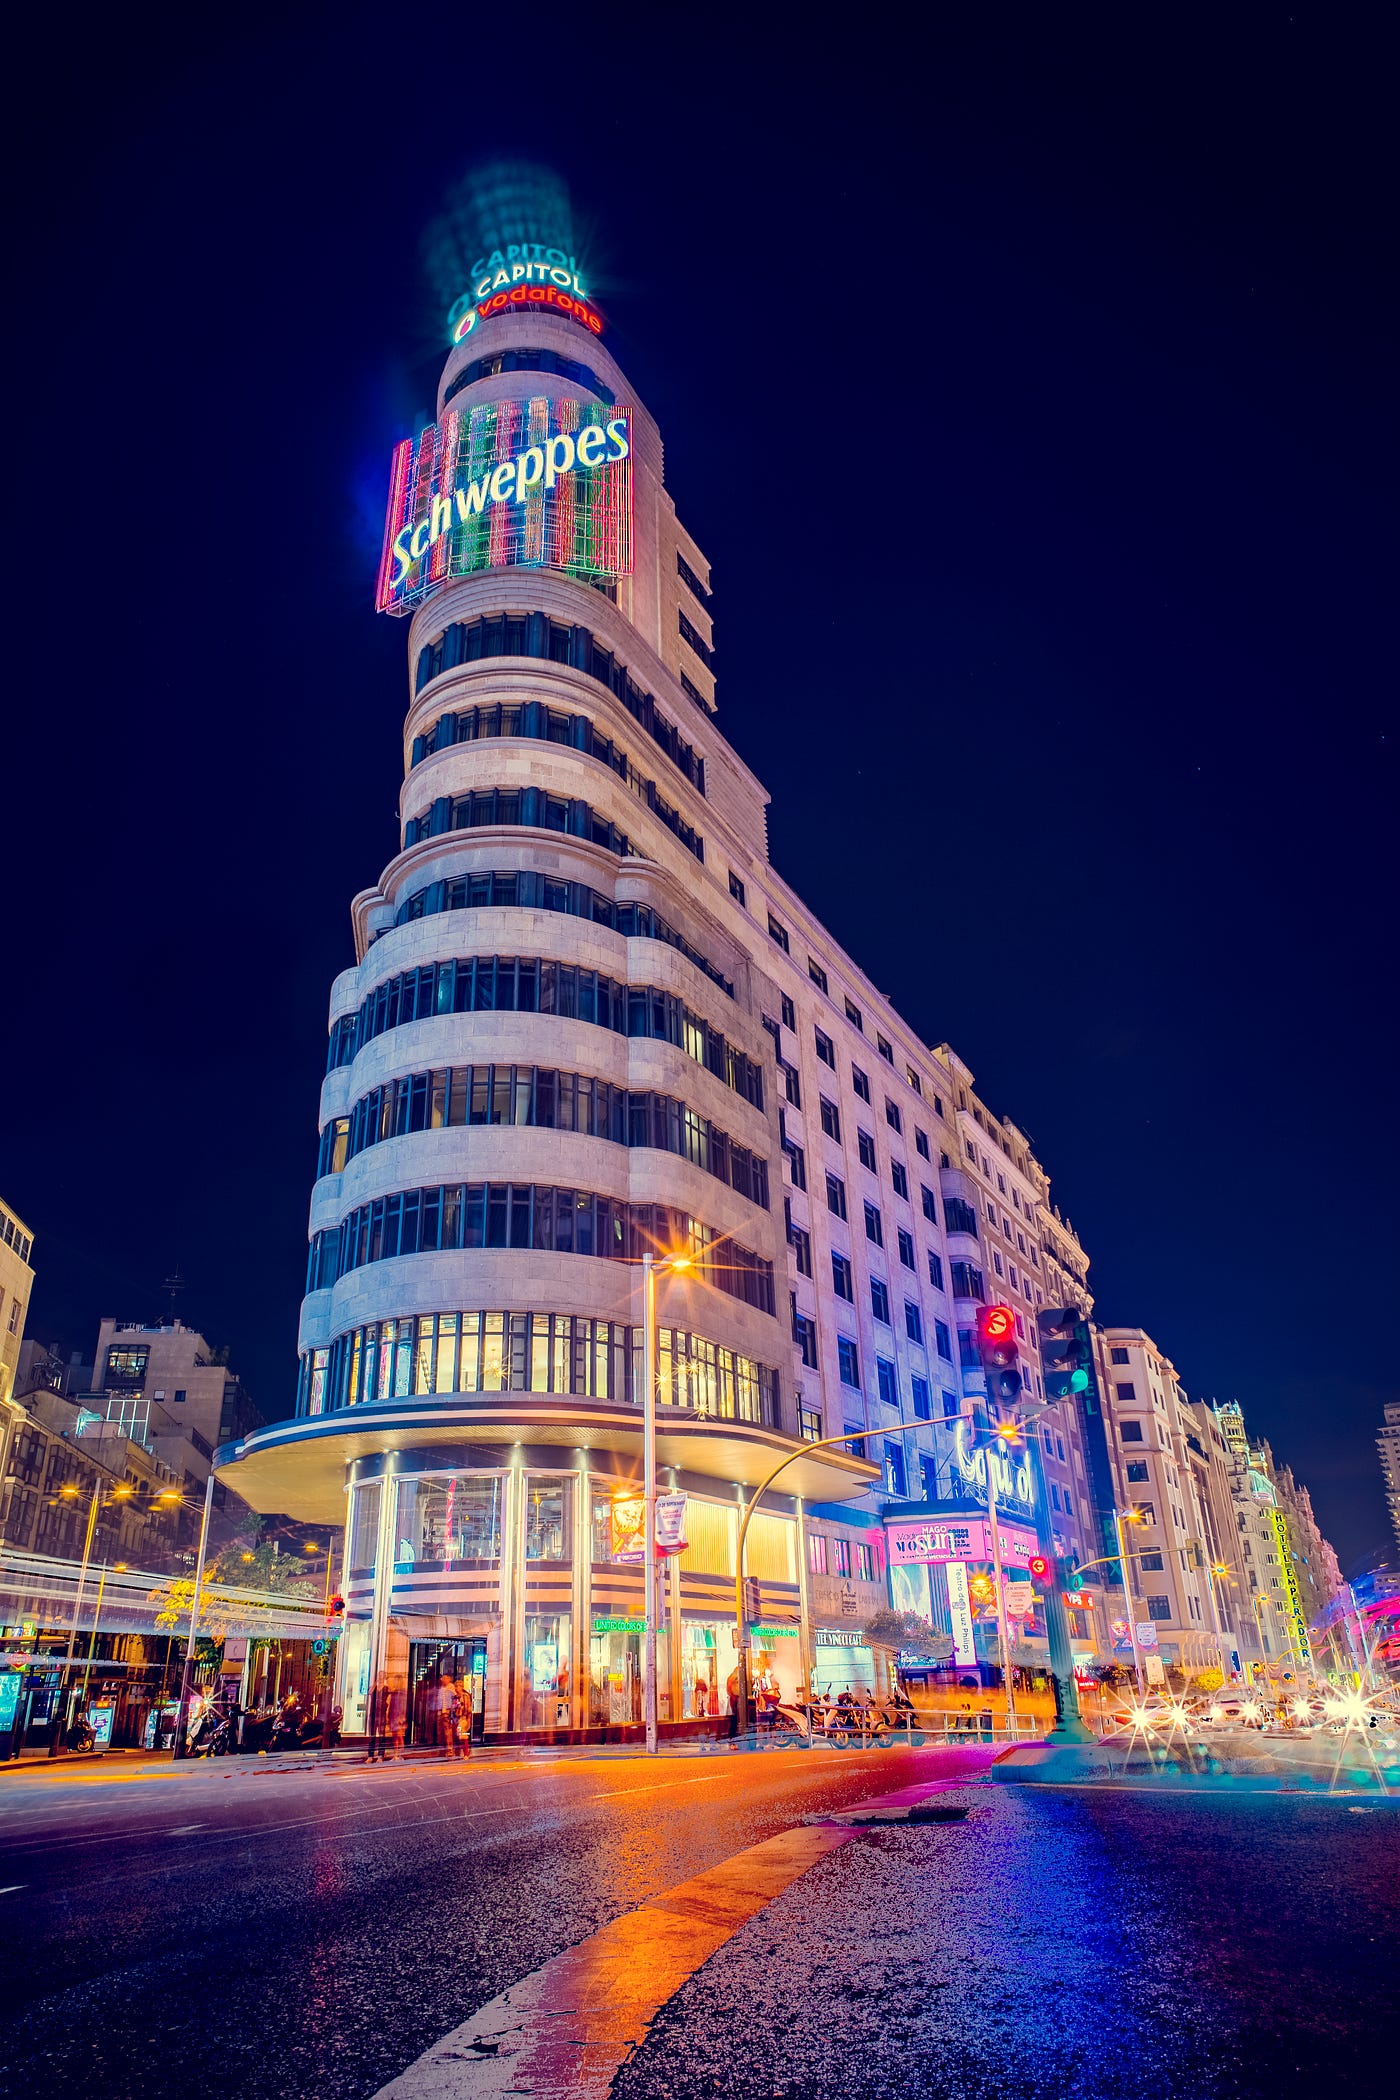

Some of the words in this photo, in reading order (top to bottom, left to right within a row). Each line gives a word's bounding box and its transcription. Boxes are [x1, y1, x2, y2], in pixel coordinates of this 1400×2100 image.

[477, 263, 586, 297] CAPITOL
[477, 284, 603, 334] vodafone
[390, 418, 630, 588] Schweppes
[921, 1525, 947, 1534] MAGO
[1103, 1519, 1121, 1577] REX
[955, 1567, 964, 1591] Teatro
[961, 1628, 970, 1654] Philips
[1275, 1513, 1290, 1563] HOTEL
[1286, 1568, 1311, 1659] EMPERADOR
[595, 1619, 617, 1630] UNITED
[617, 1621, 636, 1631] COLORS
